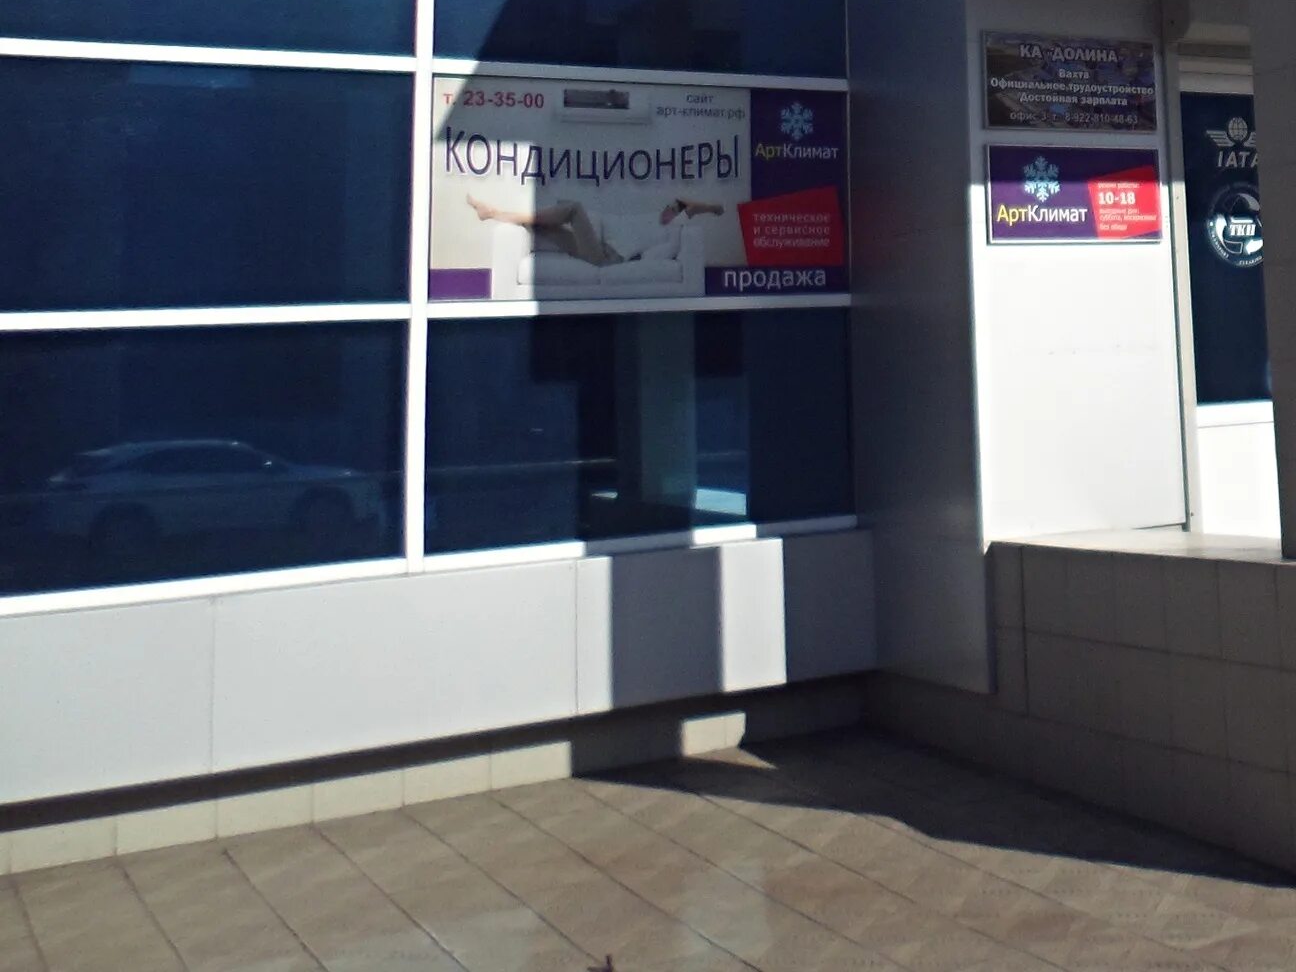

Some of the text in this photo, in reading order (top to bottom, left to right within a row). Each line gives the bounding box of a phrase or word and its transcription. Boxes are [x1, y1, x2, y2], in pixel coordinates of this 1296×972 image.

[1058, 69, 1090, 79] Вахта
[990, 77, 1066, 91] Официальное
[463, 91, 545, 109] 23-35-00
[445, 126, 740, 186] КОНДИЦИОНЕРЫ
[755, 143, 839, 160] АртКлимат
[1098, 191, 1136, 205] 10-18
[996, 204, 1087, 225] АртКлимат
[723, 268, 827, 289] продажа
